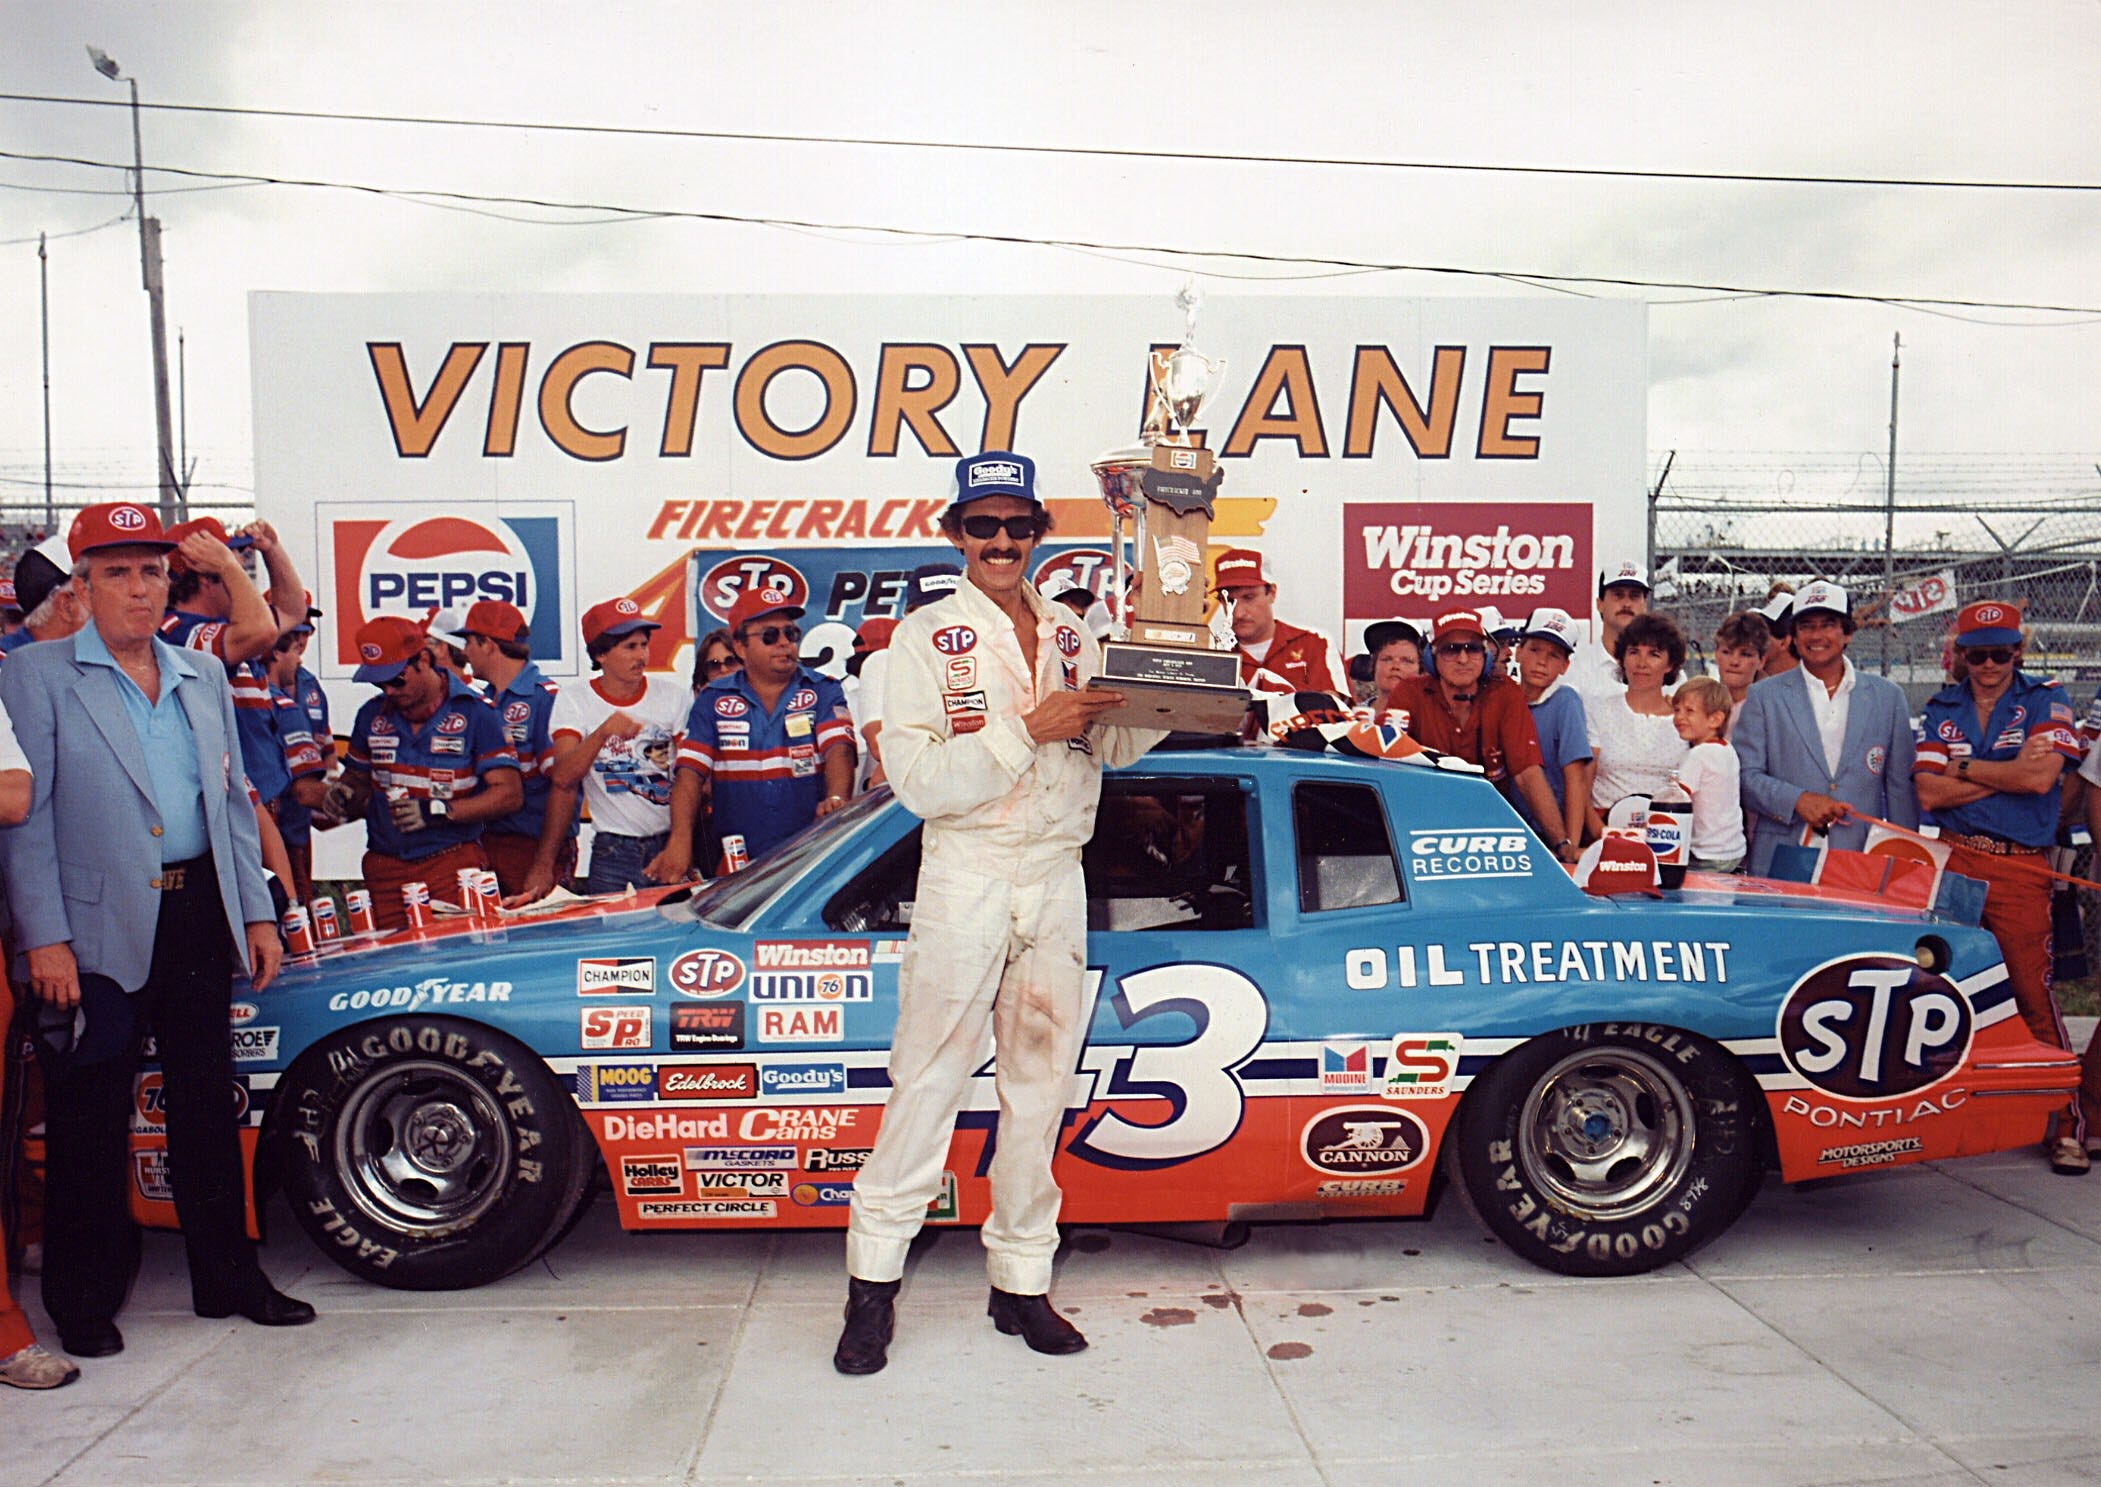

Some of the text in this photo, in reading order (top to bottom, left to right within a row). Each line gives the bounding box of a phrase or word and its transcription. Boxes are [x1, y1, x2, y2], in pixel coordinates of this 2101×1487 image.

[365, 340, 1552, 461] VICTORY LANE
[114, 509, 143, 527] STP
[646, 499, 948, 540] FIRECRACK
[1362, 525, 1574, 570] Winston
[370, 571, 527, 608] PEPSI
[713, 563, 794, 608] STP
[1390, 569, 1546, 601] Cup Series
[938, 628, 975, 651] STP
[1057, 629, 1080, 652] STP
[718, 698, 746, 714] STP
[947, 697, 984, 708] CHAMPION
[953, 717, 985, 728] Winston
[1411, 836, 1528, 855] CURB
[1412, 854, 1533, 874] RECORDS
[1599, 859, 1647, 873] Winston
[757, 944, 869, 966] Winston
[1344, 940, 1730, 990] OIL TREATMENT
[584, 970, 650, 983] CHAMPION
[678, 953, 735, 989] STP
[328, 977, 514, 1011] GOODYEAR
[677, 1008, 736, 1028] TRW
[765, 1010, 838, 1035] RAM
[1795, 968, 1960, 1082] STP
[232, 1030, 263, 1047] ROE
[1602, 1022, 1700, 1064] EAGLE
[600, 1067, 652, 1086] MOOG
[665, 1072, 748, 1092] Edelbrock
[763, 1069, 844, 1087] Goody's
[1324, 1073, 1367, 1085] MODINE
[1386, 1086, 1445, 1095] SAUNDERS
[361, 1026, 545, 1184] GOODYEAR
[1781, 1088, 1967, 1129] PONTIAC
[136, 1126, 167, 1135] GASOL
[604, 1113, 729, 1141] DieHard
[1319, 1151, 1411, 1163] CANNON
[1818, 1137, 1922, 1161] MOTORSPORTS
[1841, 1153, 1896, 1169] DESIGNS
[624, 1164, 679, 1180] Holley
[700, 1173, 784, 1188] VICTOR
[643, 1202, 770, 1213] PERFECT CIRCLE
[1488, 1138, 1691, 1261] GOODYEAR
[308, 1196, 400, 1271] EAGLE
